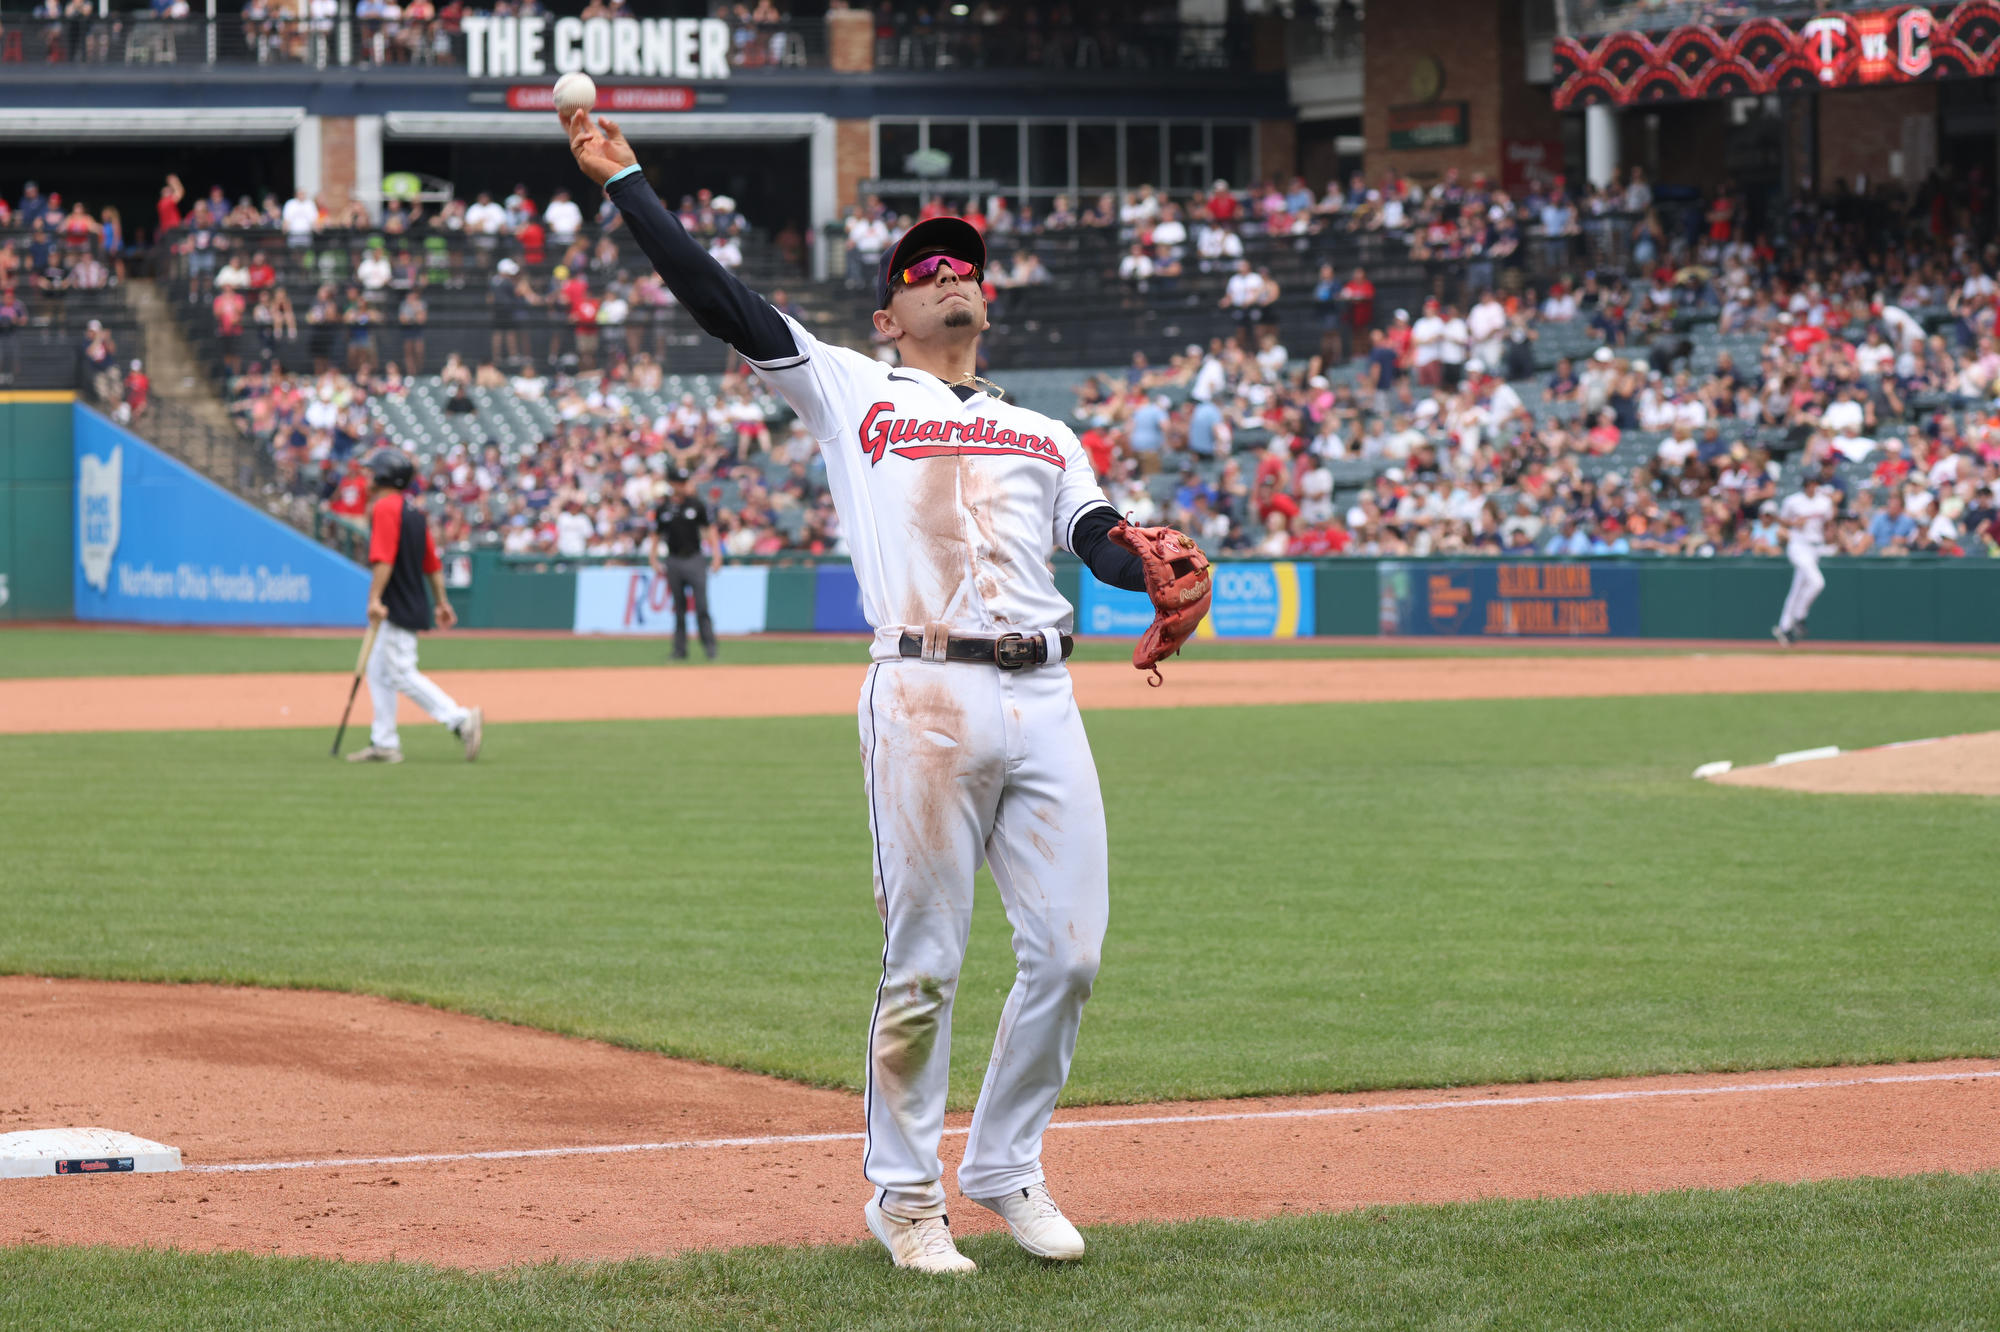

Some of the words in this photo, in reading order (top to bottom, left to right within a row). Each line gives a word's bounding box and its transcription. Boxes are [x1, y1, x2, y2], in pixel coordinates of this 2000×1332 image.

[461, 16, 546, 78] THE
[554, 16, 731, 79] CORNER
[859, 401, 1066, 471] Guardians
[119, 562, 174, 597] Northern
[177, 562, 208, 600] Ohio
[210, 563, 254, 602] Honda
[256, 563, 311, 603] Dealers
[1180, 577, 1208, 603] Rawlings
[1218, 573, 1274, 600] 100%
[1497, 562, 1539, 592] SLOW
[1542, 562, 1592, 592] DOWN
[1557, 599, 1609, 628] ZONES
[59, 1161, 68, 1174] C
[80, 1160, 109, 1171] Guardians
